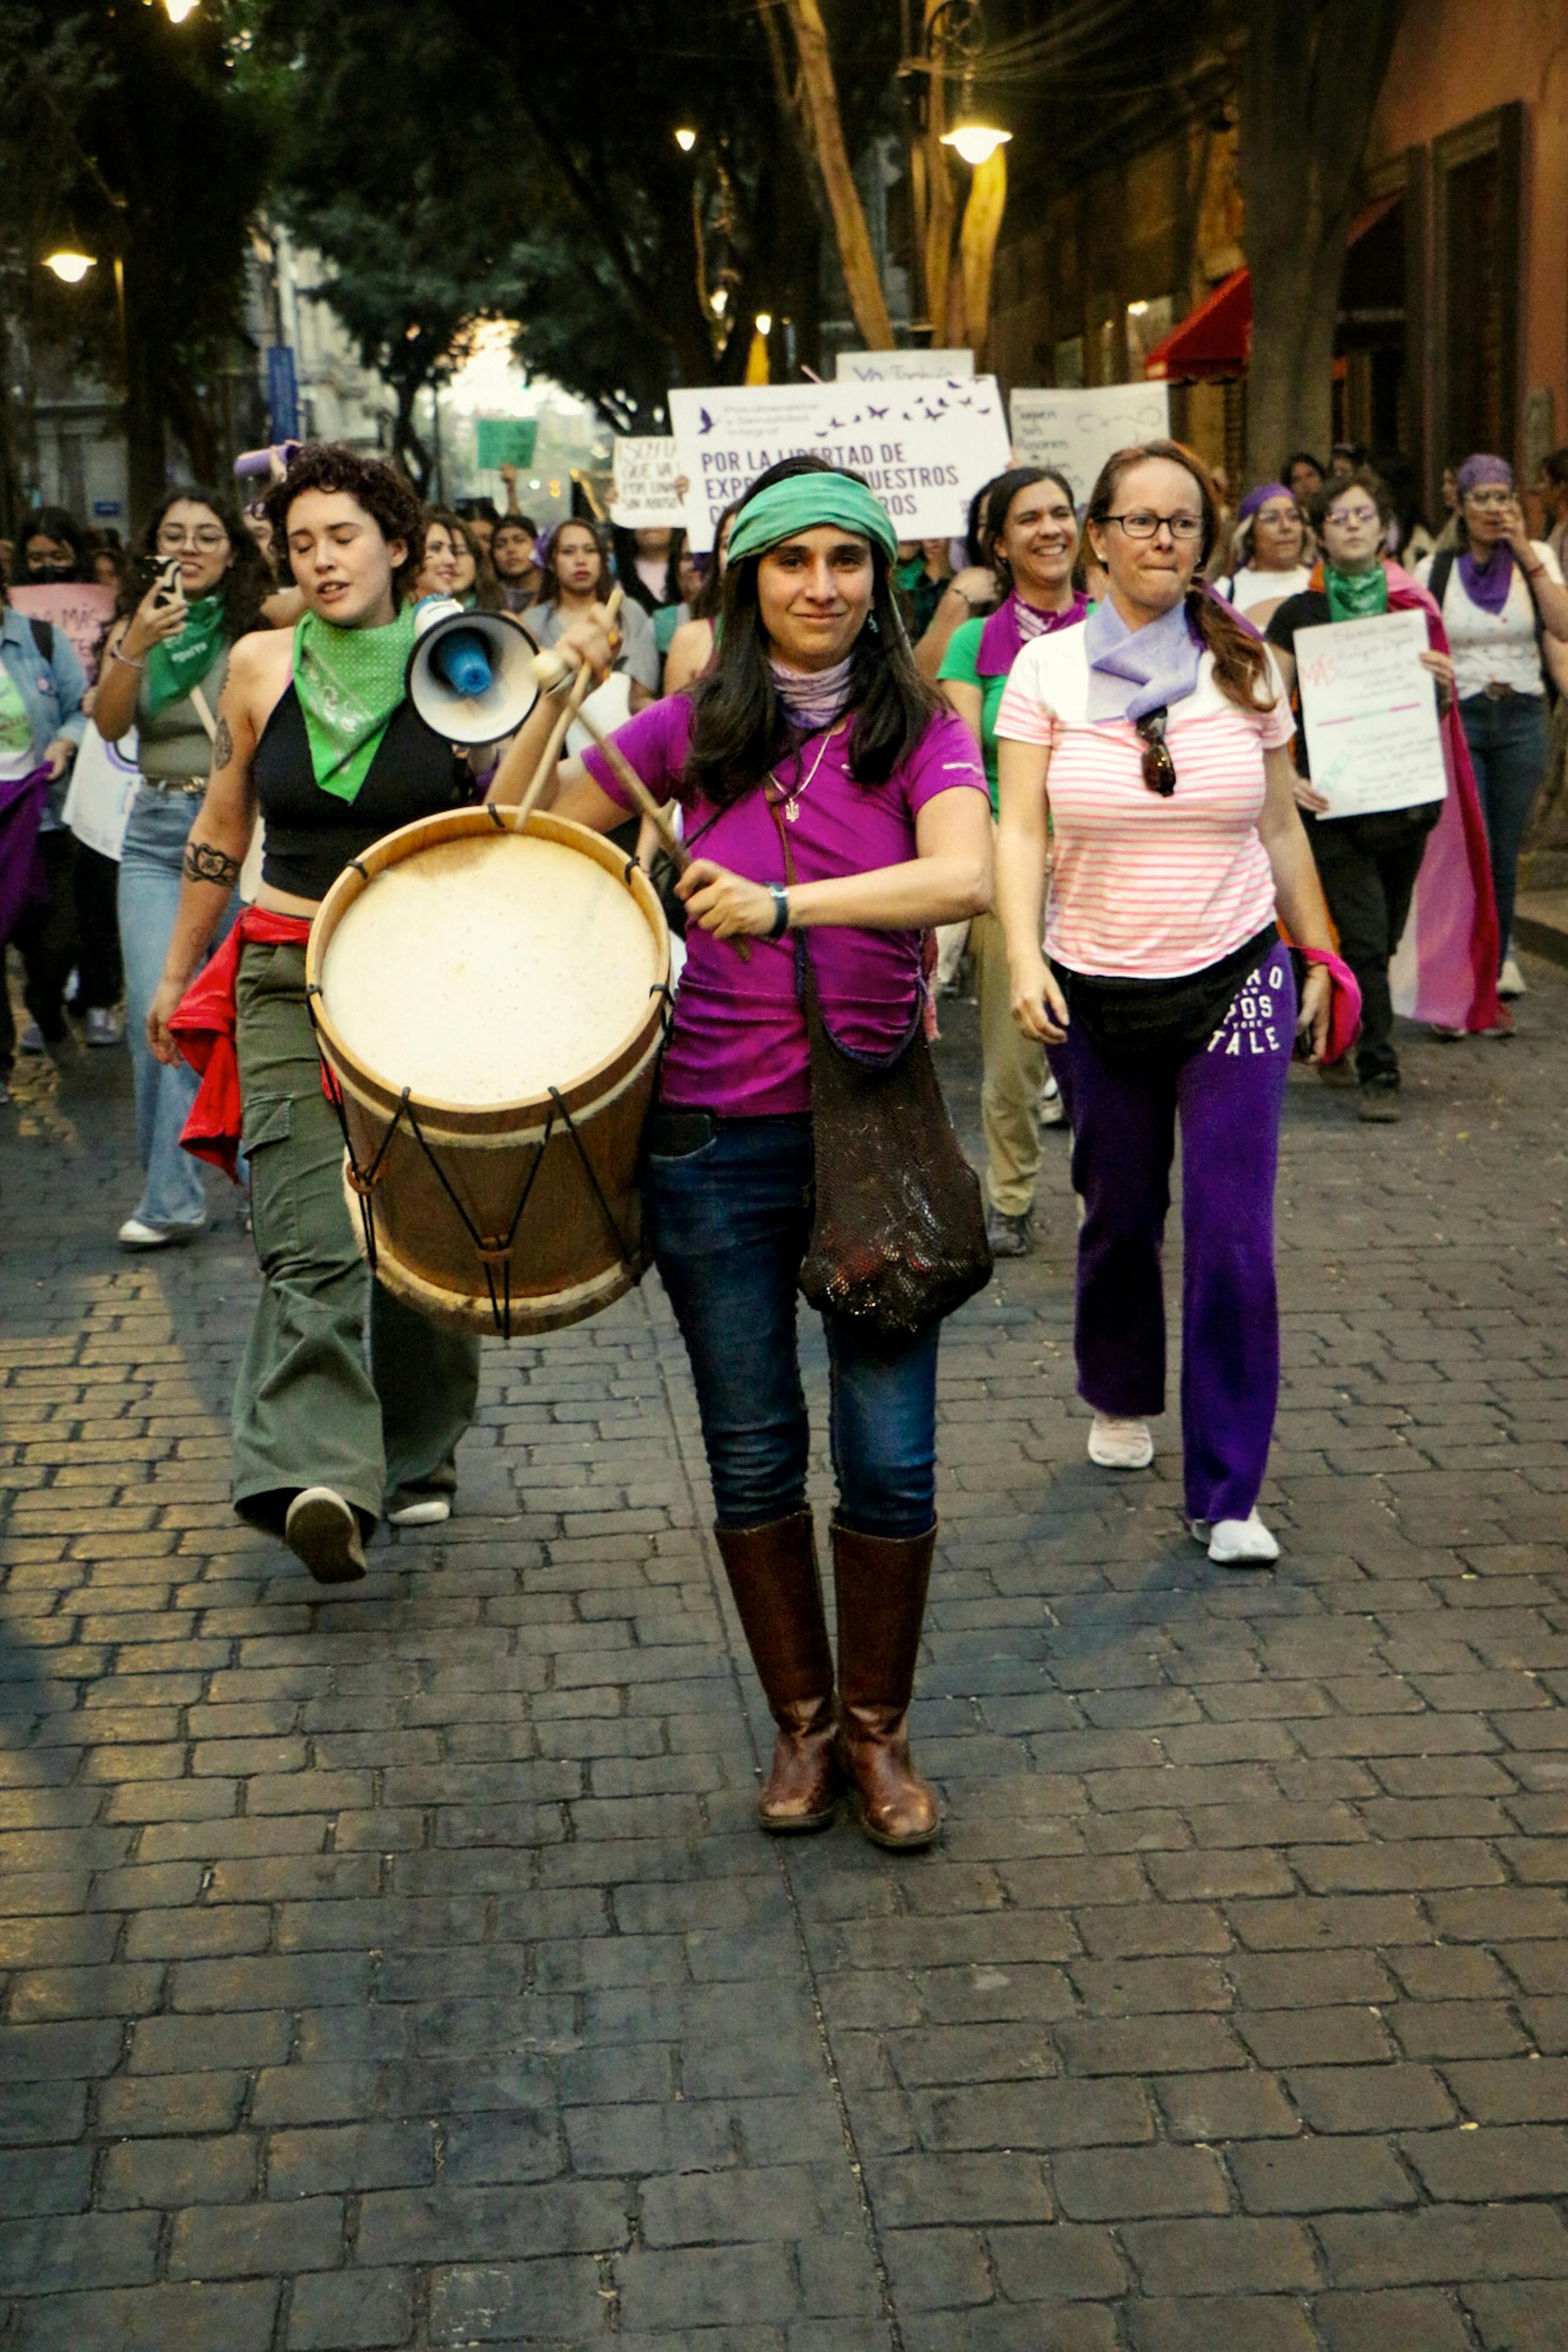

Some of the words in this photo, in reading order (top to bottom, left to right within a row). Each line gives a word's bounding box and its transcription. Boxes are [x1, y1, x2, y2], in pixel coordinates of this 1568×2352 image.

[701, 452, 740, 473] POR
[746, 450, 772, 470] LA
[778, 445, 873, 469] LRTAD
[880, 442, 906, 463] DE
[1207, 1026, 1280, 1055] TALE
